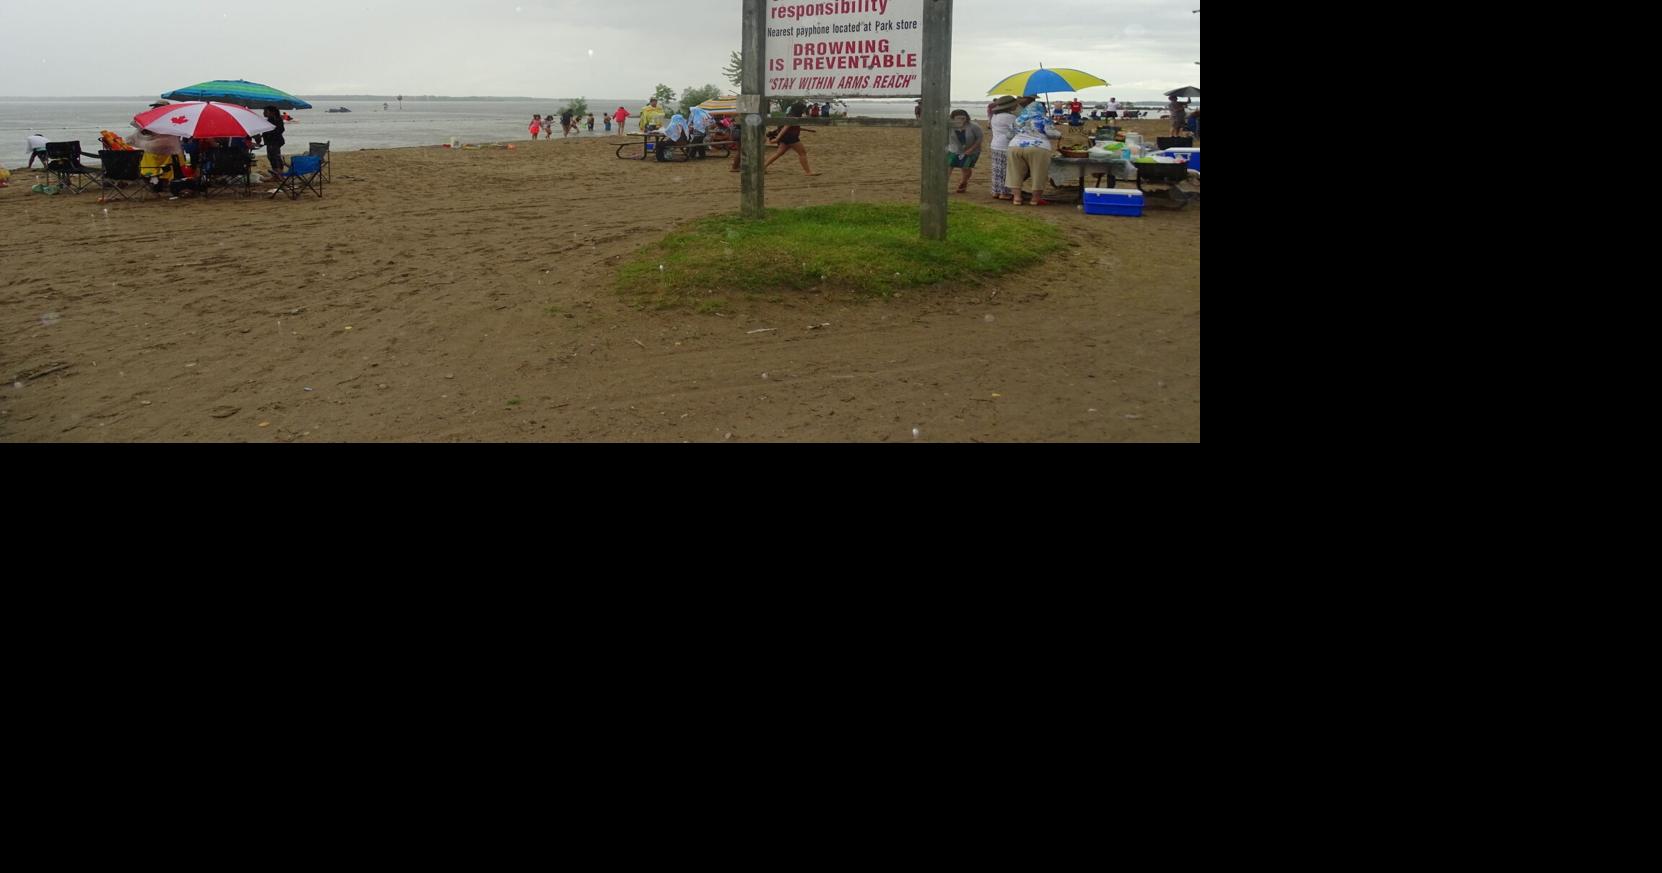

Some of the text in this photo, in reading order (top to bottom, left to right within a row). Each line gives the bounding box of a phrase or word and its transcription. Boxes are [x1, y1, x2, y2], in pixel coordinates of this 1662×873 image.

[767, 19, 918, 38] Nearest payphone located at Park store
[793, 39, 889, 56] DROWNING
[769, 54, 917, 72] IS PREVENTABLE
[769, 74, 917, 90] "STAY WITHIN ARMS REACH"
